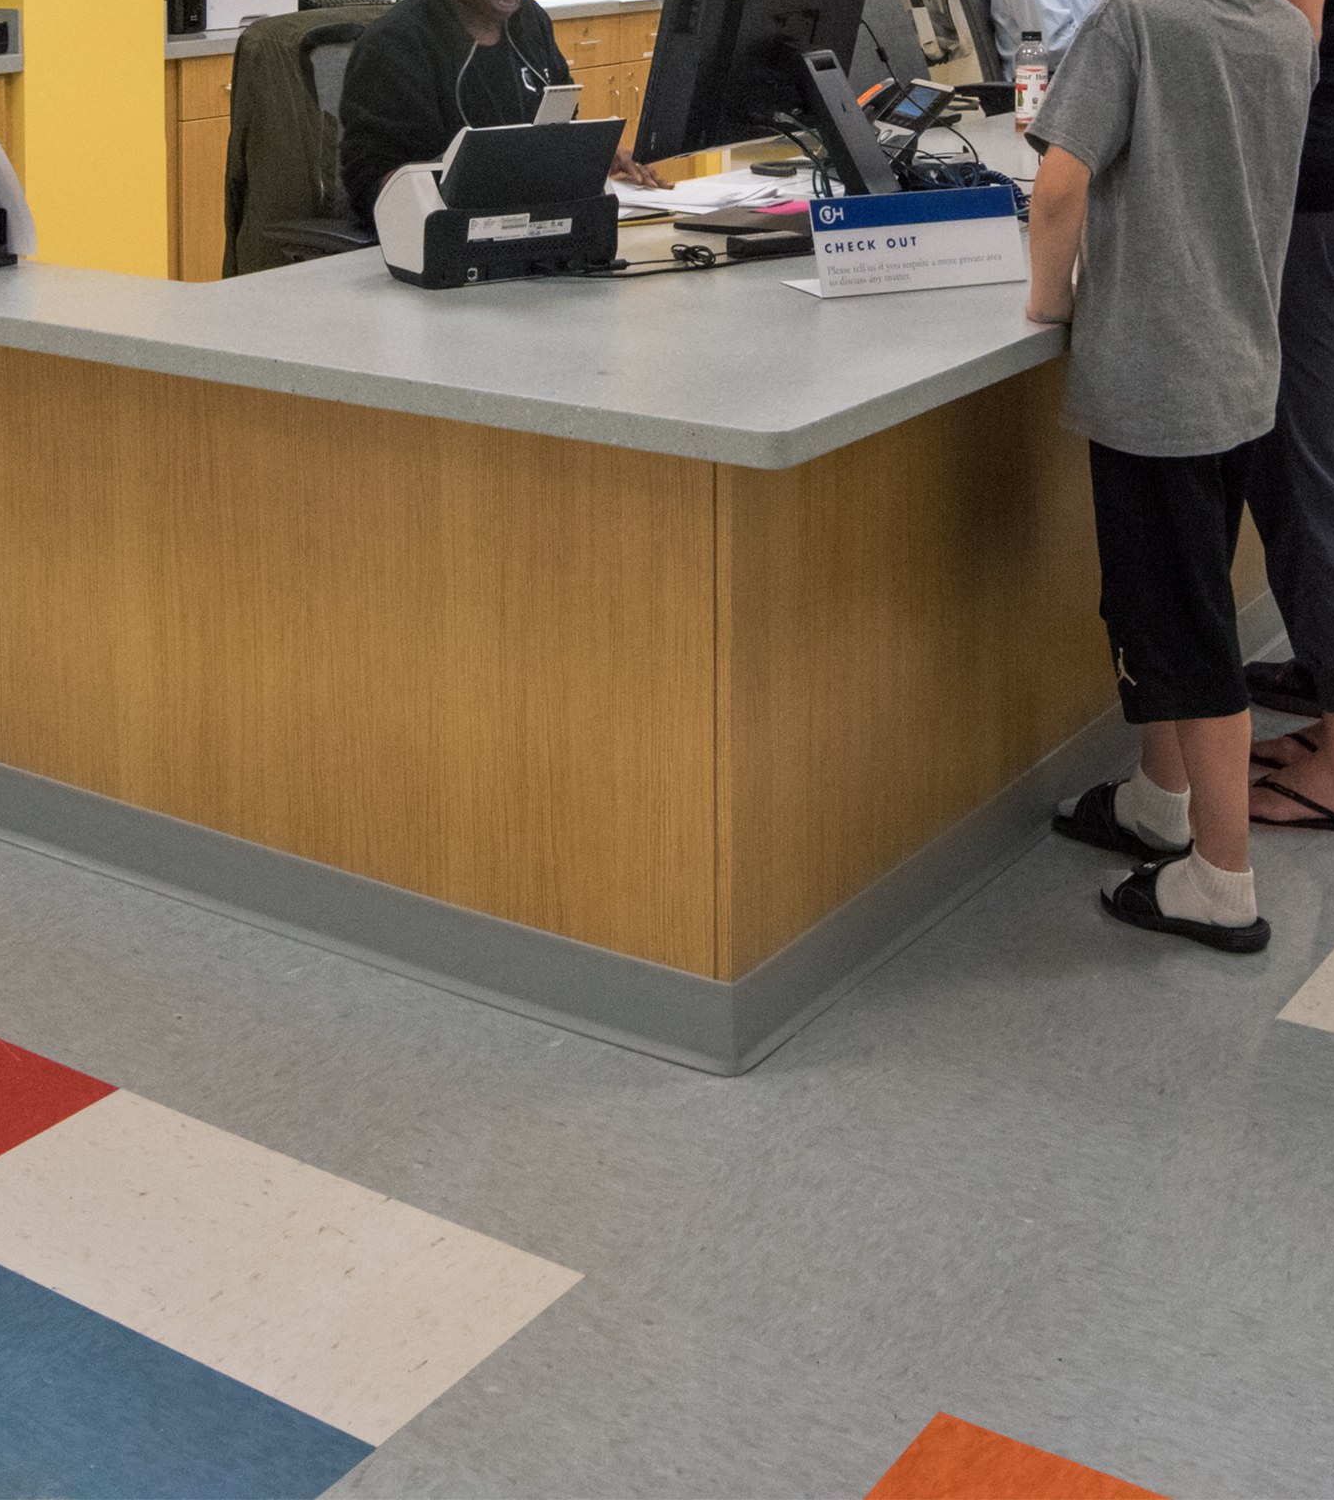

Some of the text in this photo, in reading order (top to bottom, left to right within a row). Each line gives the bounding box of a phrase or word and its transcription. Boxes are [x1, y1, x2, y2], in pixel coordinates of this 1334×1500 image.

[825, 236, 917, 254] CHECK OUT
[827, 266, 850, 275] Please
[853, 263, 865, 273] tell
[886, 263, 901, 273] you
[903, 259, 929, 270] require
[959, 255, 985, 266] private
[839, 274, 867, 286] discuss
